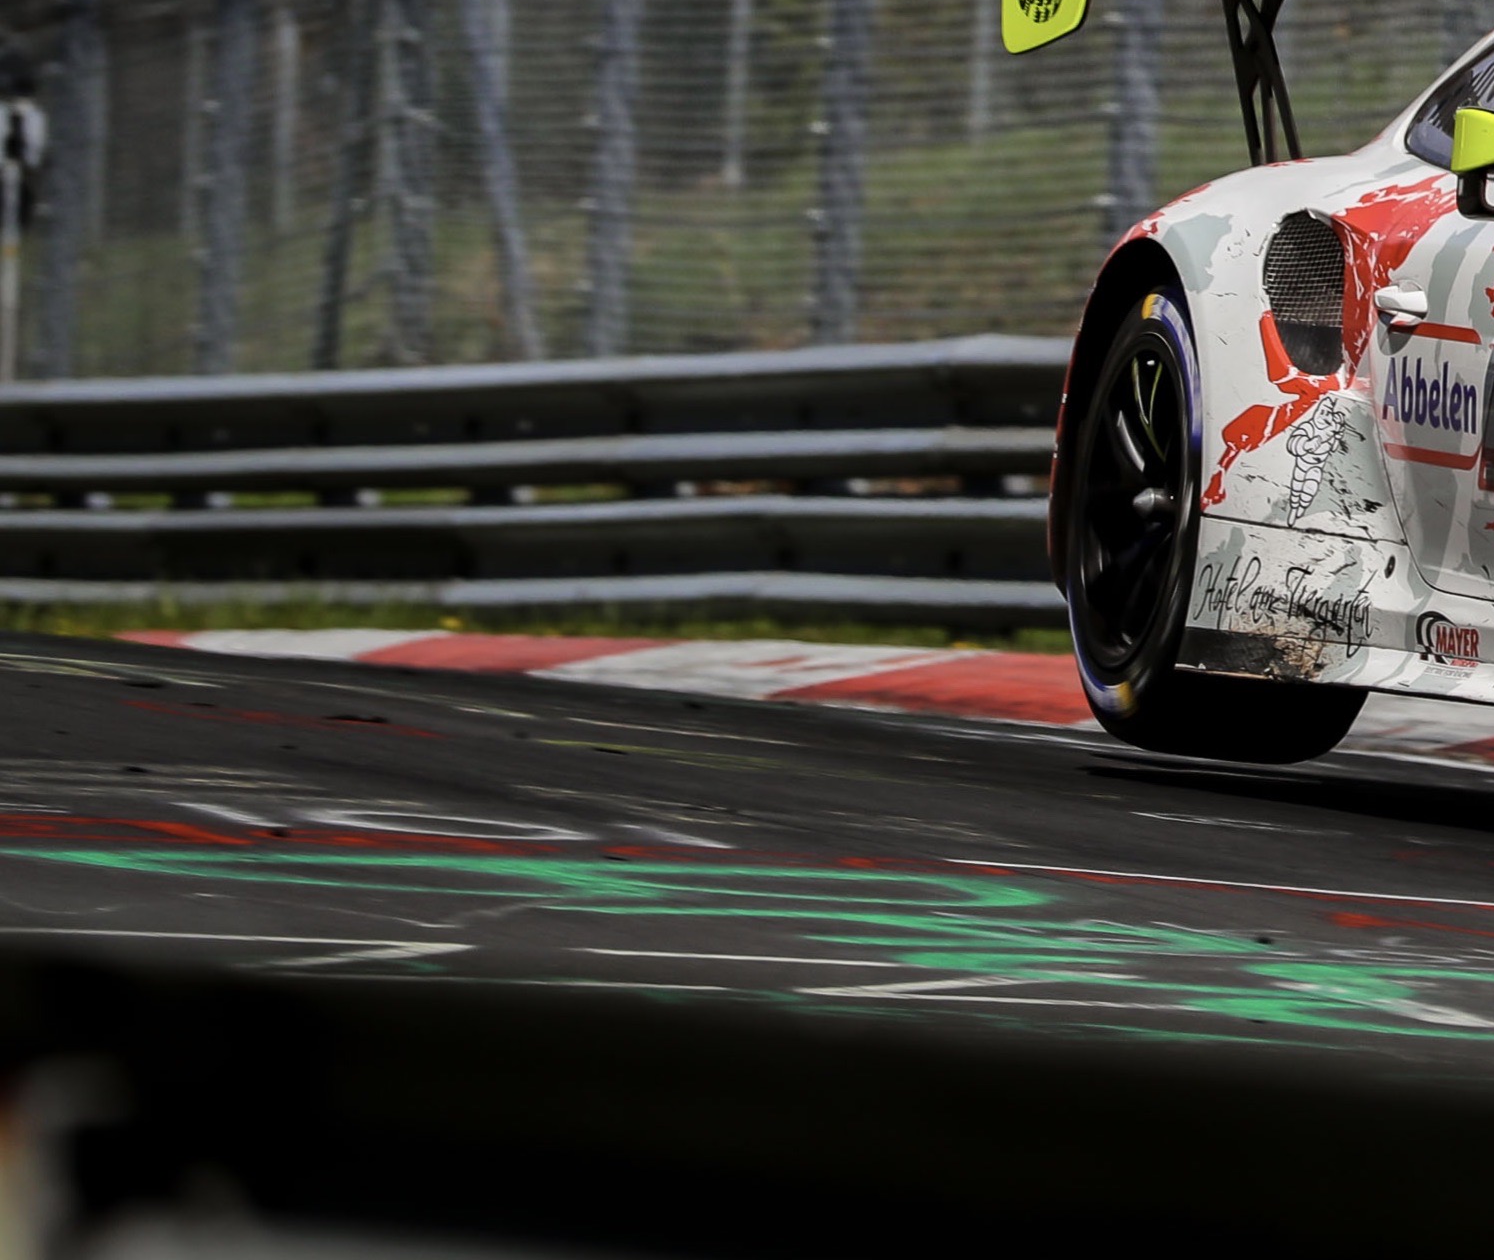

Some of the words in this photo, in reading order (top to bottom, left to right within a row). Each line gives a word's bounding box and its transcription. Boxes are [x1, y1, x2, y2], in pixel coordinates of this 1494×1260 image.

[1383, 356, 1478, 435] Abbelen
[1193, 556, 1262, 630] Hotel
[1435, 625, 1480, 658] MAYER
